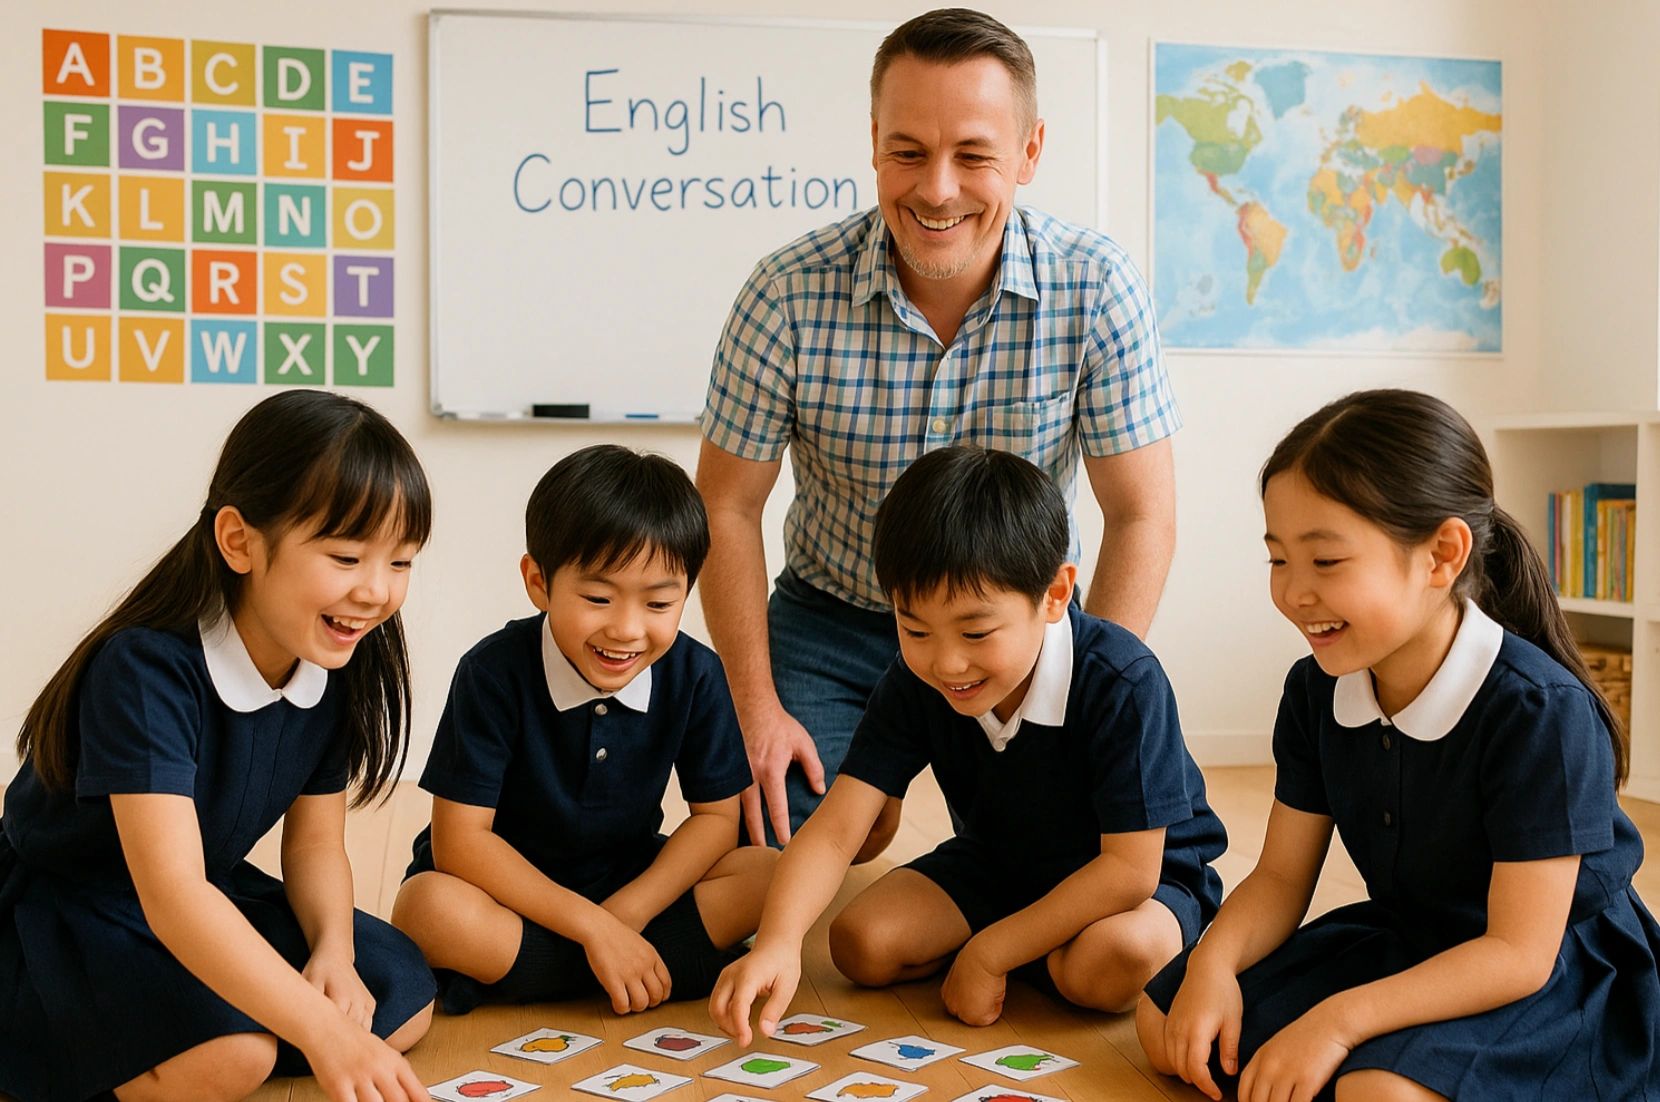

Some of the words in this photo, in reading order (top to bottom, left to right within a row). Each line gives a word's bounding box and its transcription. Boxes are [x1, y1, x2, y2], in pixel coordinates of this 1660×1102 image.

[57, 43, 94, 85] A
[135, 48, 165, 89] B
[205, 53, 238, 95] C
[278, 58, 311, 101] D
[349, 62, 374, 104] E
[585, 69, 786, 156] English
[64, 113, 93, 155] F
[132, 118, 169, 159] G
[207, 122, 240, 164] H
[284, 127, 307, 169] I
[348, 131, 379, 171] J
[62, 184, 95, 227] K
[140, 189, 163, 229] L
[203, 191, 244, 233] M
[278, 194, 311, 236] N
[345, 199, 382, 240] O
[514, 153, 857, 213] Conversation
[64, 256, 95, 298] P
[132, 258, 174, 303] Q
[210, 262, 239, 304] R
[280, 263, 308, 304] S
[345, 265, 381, 308] T
[63, 326, 94, 368] U
[135, 330, 170, 371] V
[201, 330, 247, 374] W
[278, 333, 312, 375] X
[346, 336, 380, 375] Y
